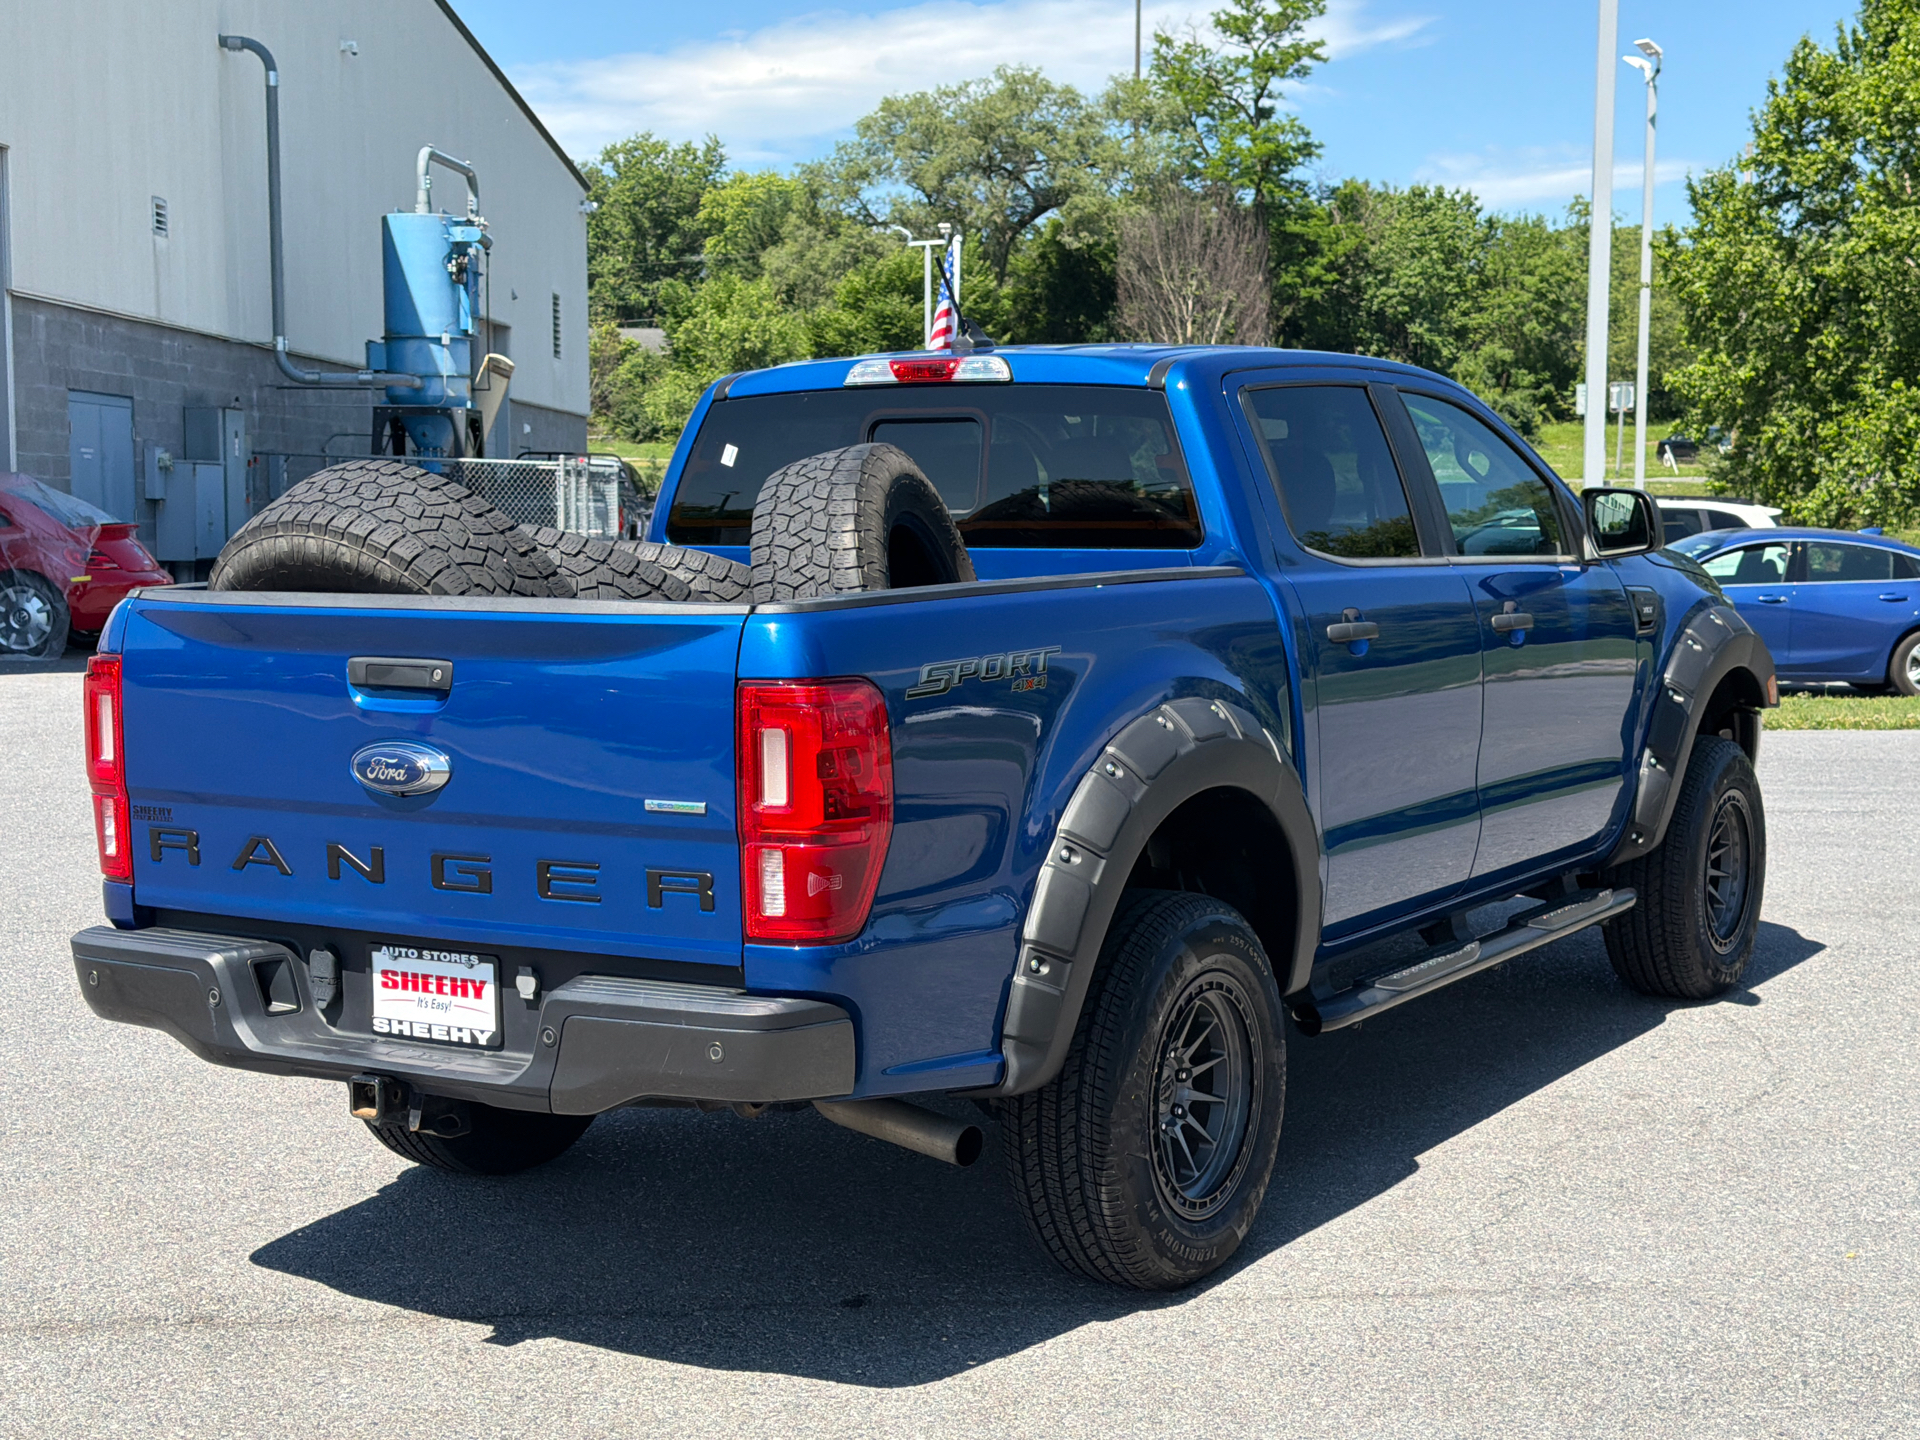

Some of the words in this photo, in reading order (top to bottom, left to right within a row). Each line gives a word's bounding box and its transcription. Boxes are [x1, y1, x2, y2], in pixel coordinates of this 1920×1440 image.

[905, 645, 1061, 701] SPORT
[366, 756, 408, 781] Ford
[132, 804, 173, 817] SHEEHY
[149, 826, 715, 912] RANGER
[380, 945, 419, 959] AUTO
[422, 951, 479, 964] STORES
[380, 969, 488, 1000] SHEEHY
[416, 997, 429, 1009] It's
[431, 999, 452, 1013] Easy!
[372, 1017, 494, 1046] SHEEHY
[1159, 1228, 1218, 1262] TERRITORY
